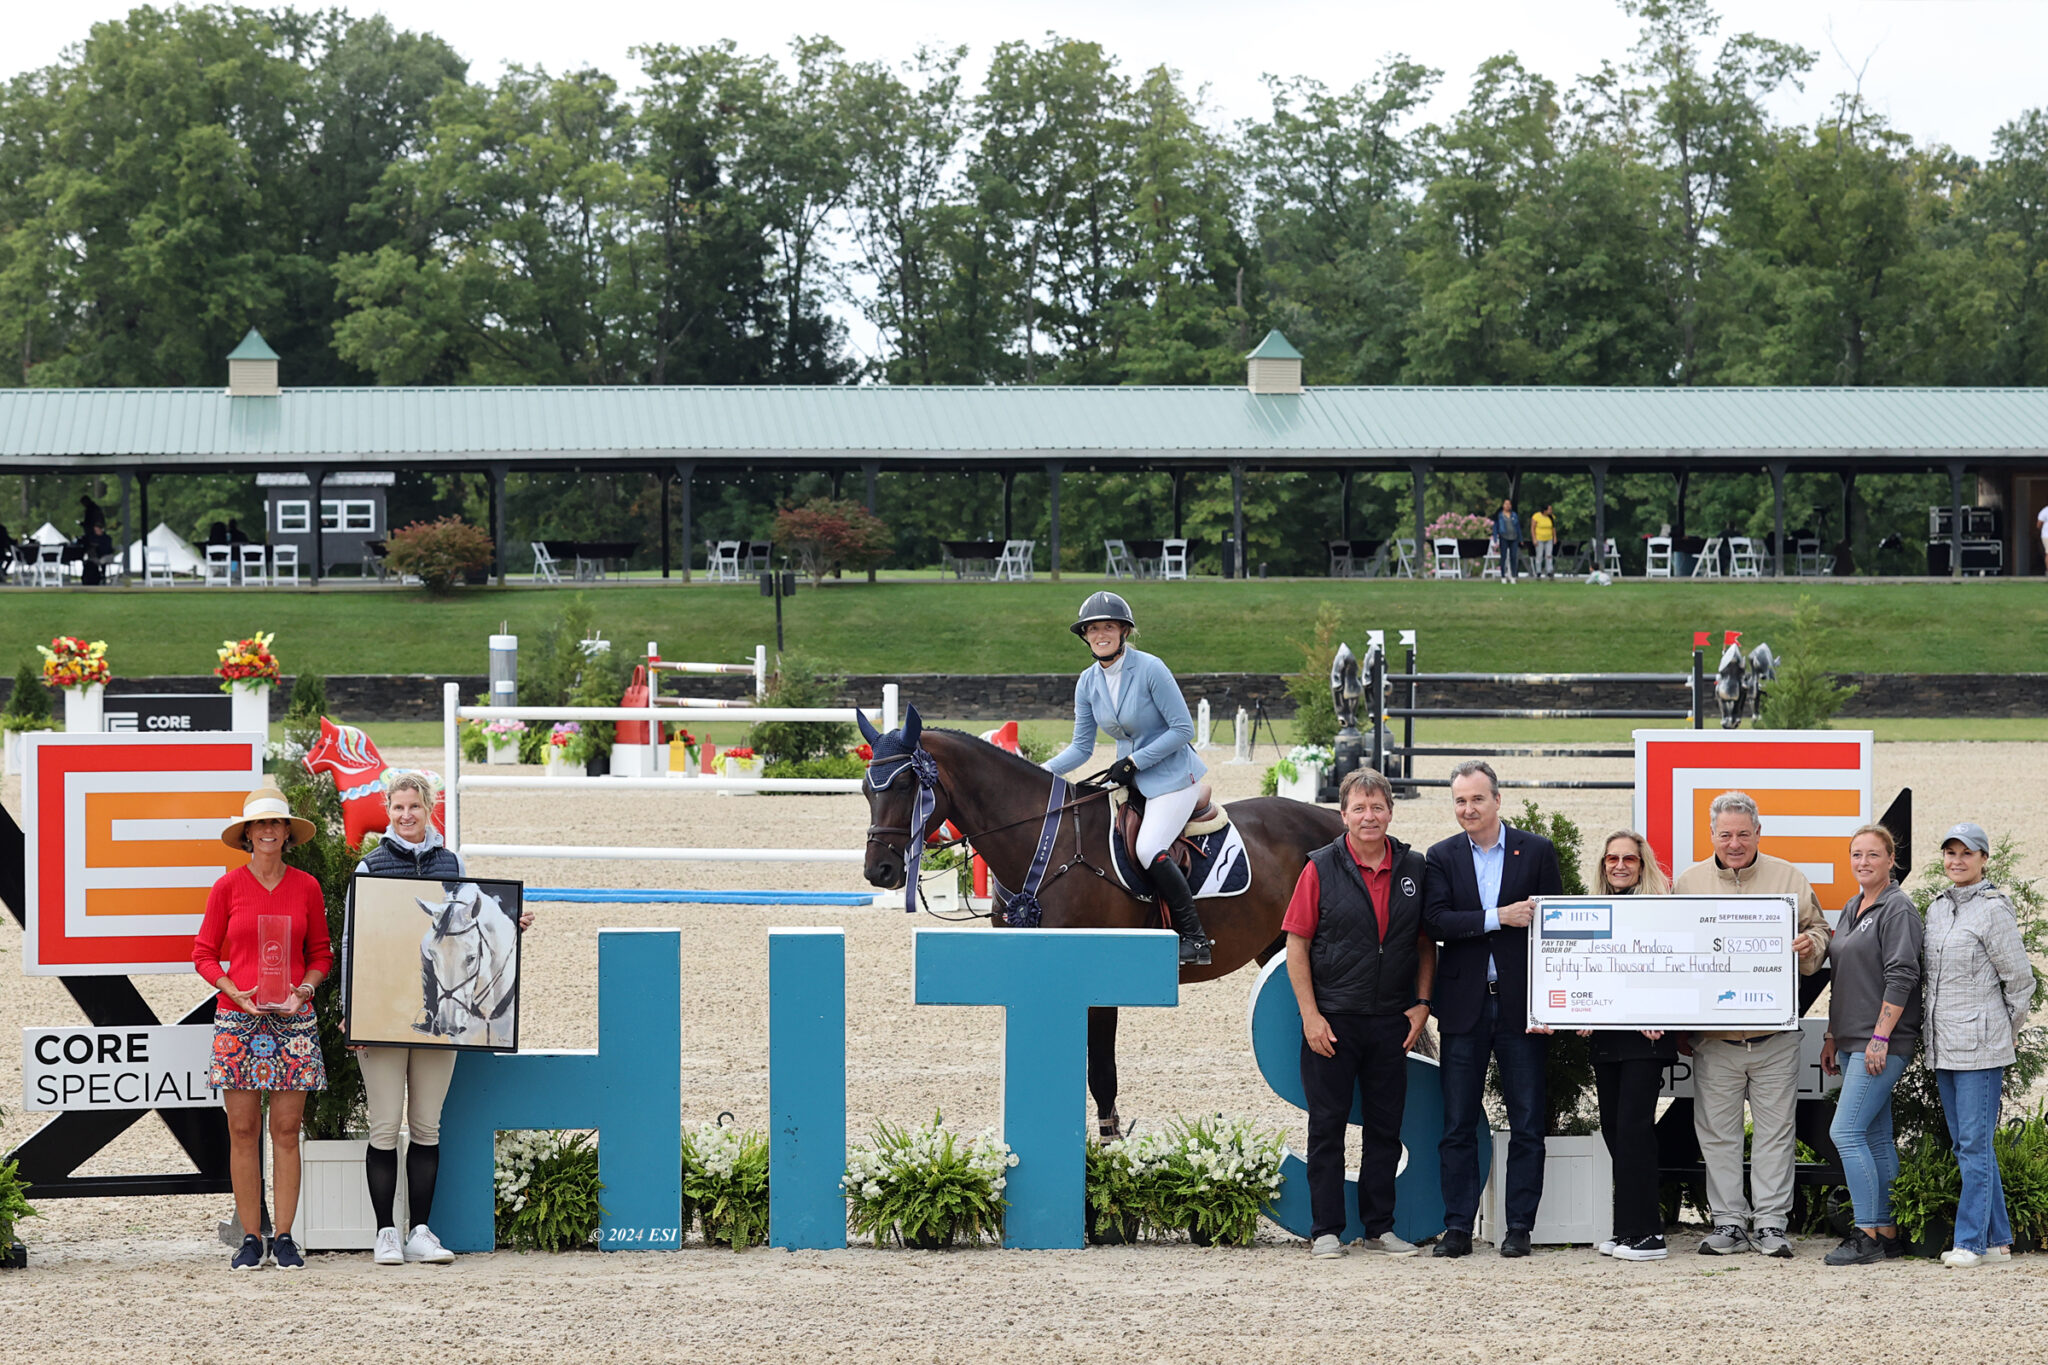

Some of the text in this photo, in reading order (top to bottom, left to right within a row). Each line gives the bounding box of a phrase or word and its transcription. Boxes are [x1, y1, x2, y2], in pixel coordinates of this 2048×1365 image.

[146, 715, 191, 729] CORE
[1570, 911, 1599, 921] HITS
[1588, 939, 1673, 953] Jessica Mendoza
[1607, 956, 1655, 972] Thousand
[1665, 956, 1686, 972] Five
[1689, 955, 1731, 972] Hundred
[1571, 991, 1594, 999] CORE
[1744, 992, 1774, 1002] HITS
[34, 1033, 149, 1065] CORE
